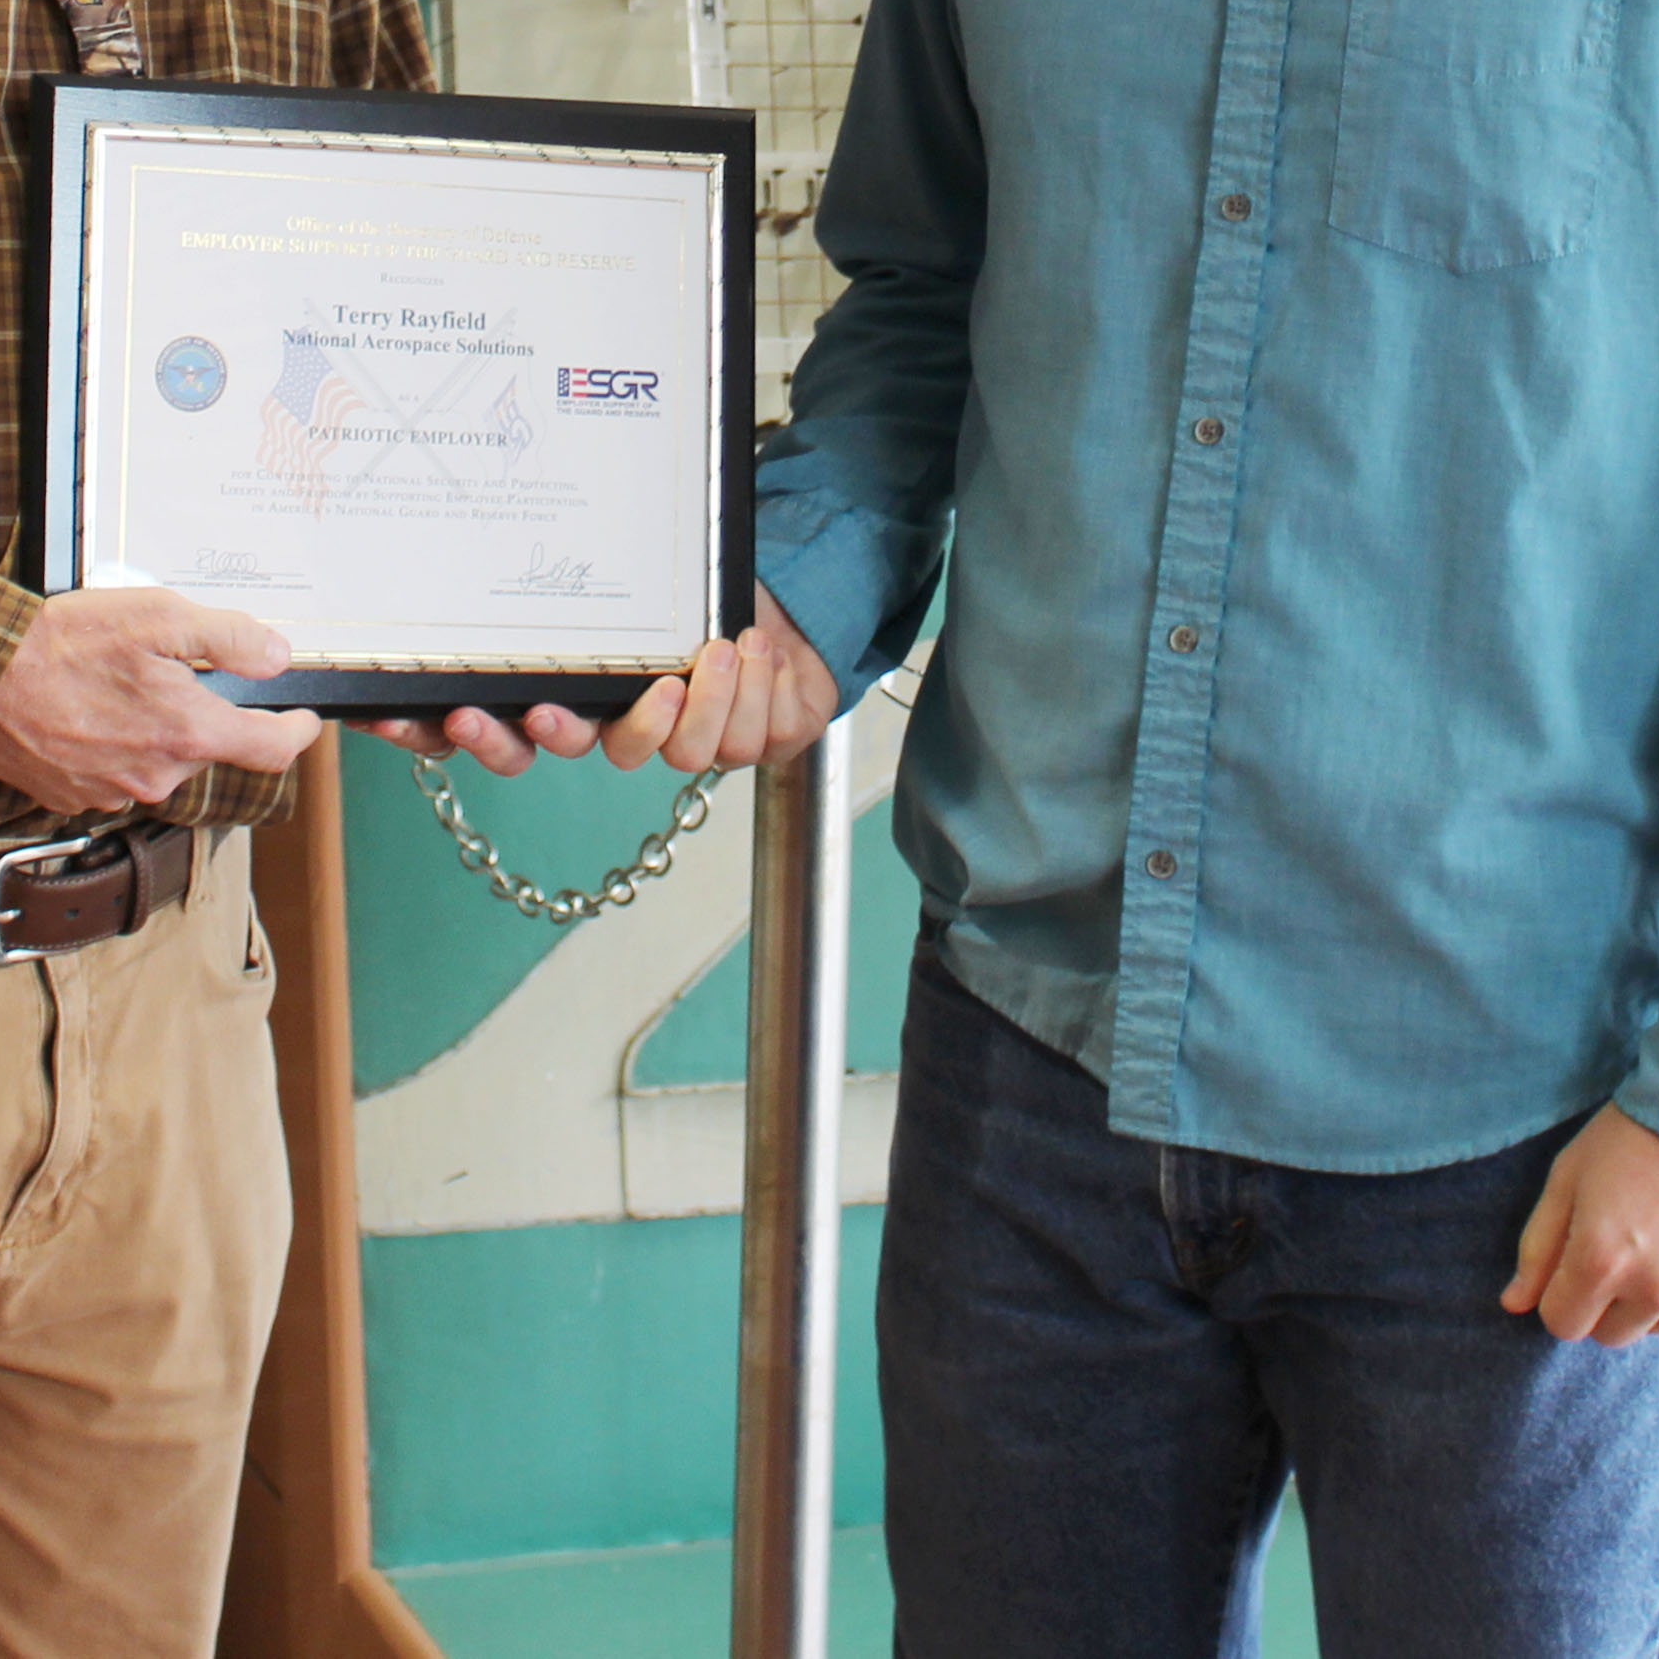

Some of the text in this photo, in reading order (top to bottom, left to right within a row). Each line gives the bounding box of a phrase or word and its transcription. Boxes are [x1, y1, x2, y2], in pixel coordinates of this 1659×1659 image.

[181, 231, 285, 253] EMPLOYER
[557, 252, 637, 273] RESERVE
[332, 304, 486, 332] Terry Rayfield
[282, 329, 535, 358] National Aerospace Solutions
[557, 367, 659, 402] ESGR
[308, 426, 508, 447] PATRIOTIC EMPLOYER
